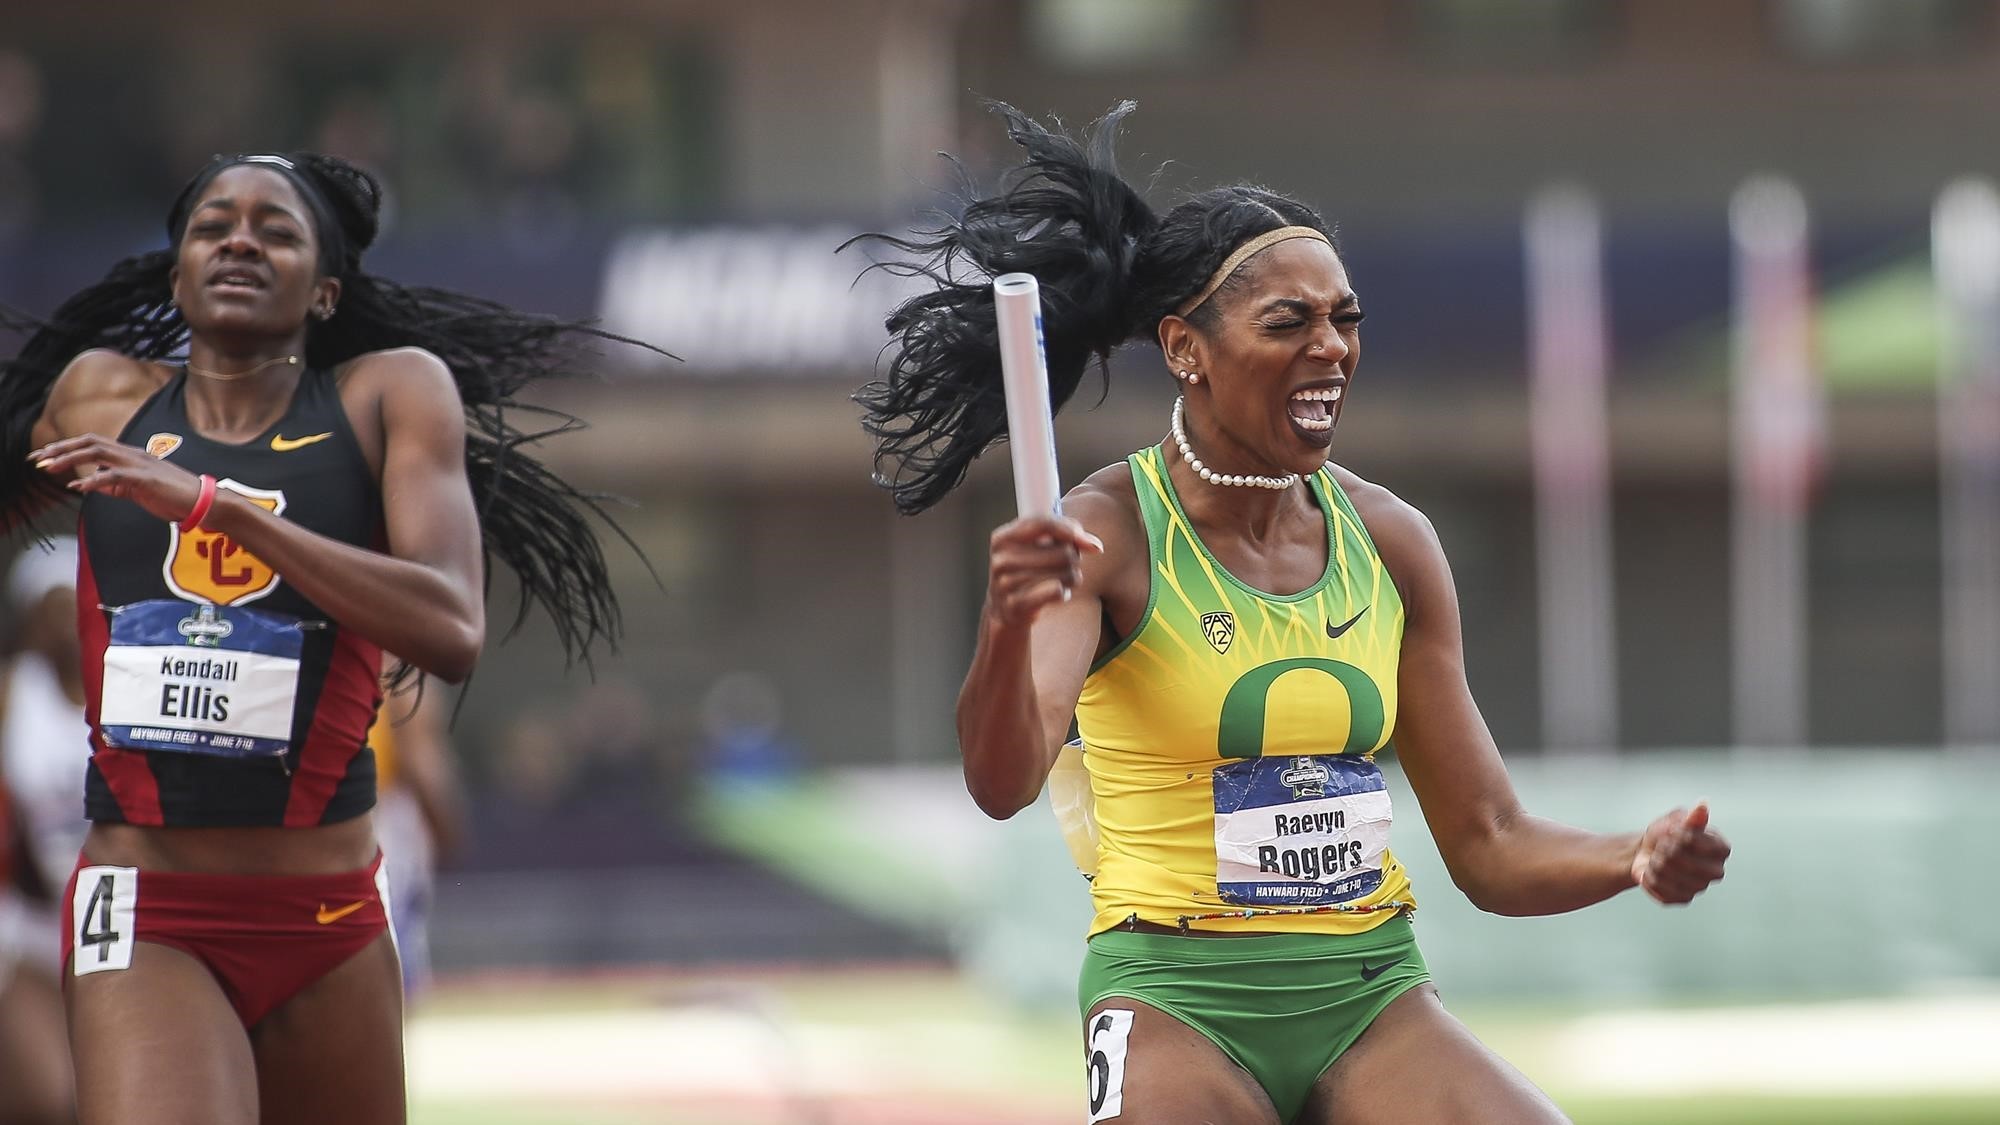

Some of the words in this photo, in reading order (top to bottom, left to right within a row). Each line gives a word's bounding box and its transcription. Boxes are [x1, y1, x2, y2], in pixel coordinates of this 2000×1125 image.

[1203, 614, 1232, 637] PAC
[1212, 630, 1228, 645] 12
[161, 656, 238, 681] Kendall
[160, 683, 229, 721] Ellis
[1217, 657, 1385, 759] O
[129, 727, 173, 742] HAYWARD
[172, 730, 198, 744] FIELD
[1275, 809, 1345, 837] Raevyn
[1258, 840, 1363, 880] Rogers
[1256, 886, 1299, 897] HAYWARD
[1300, 886, 1324, 897] FIELD
[1332, 883, 1350, 895] JUNE
[81, 874, 120, 962] 4
[1089, 1014, 1114, 1117] 6
